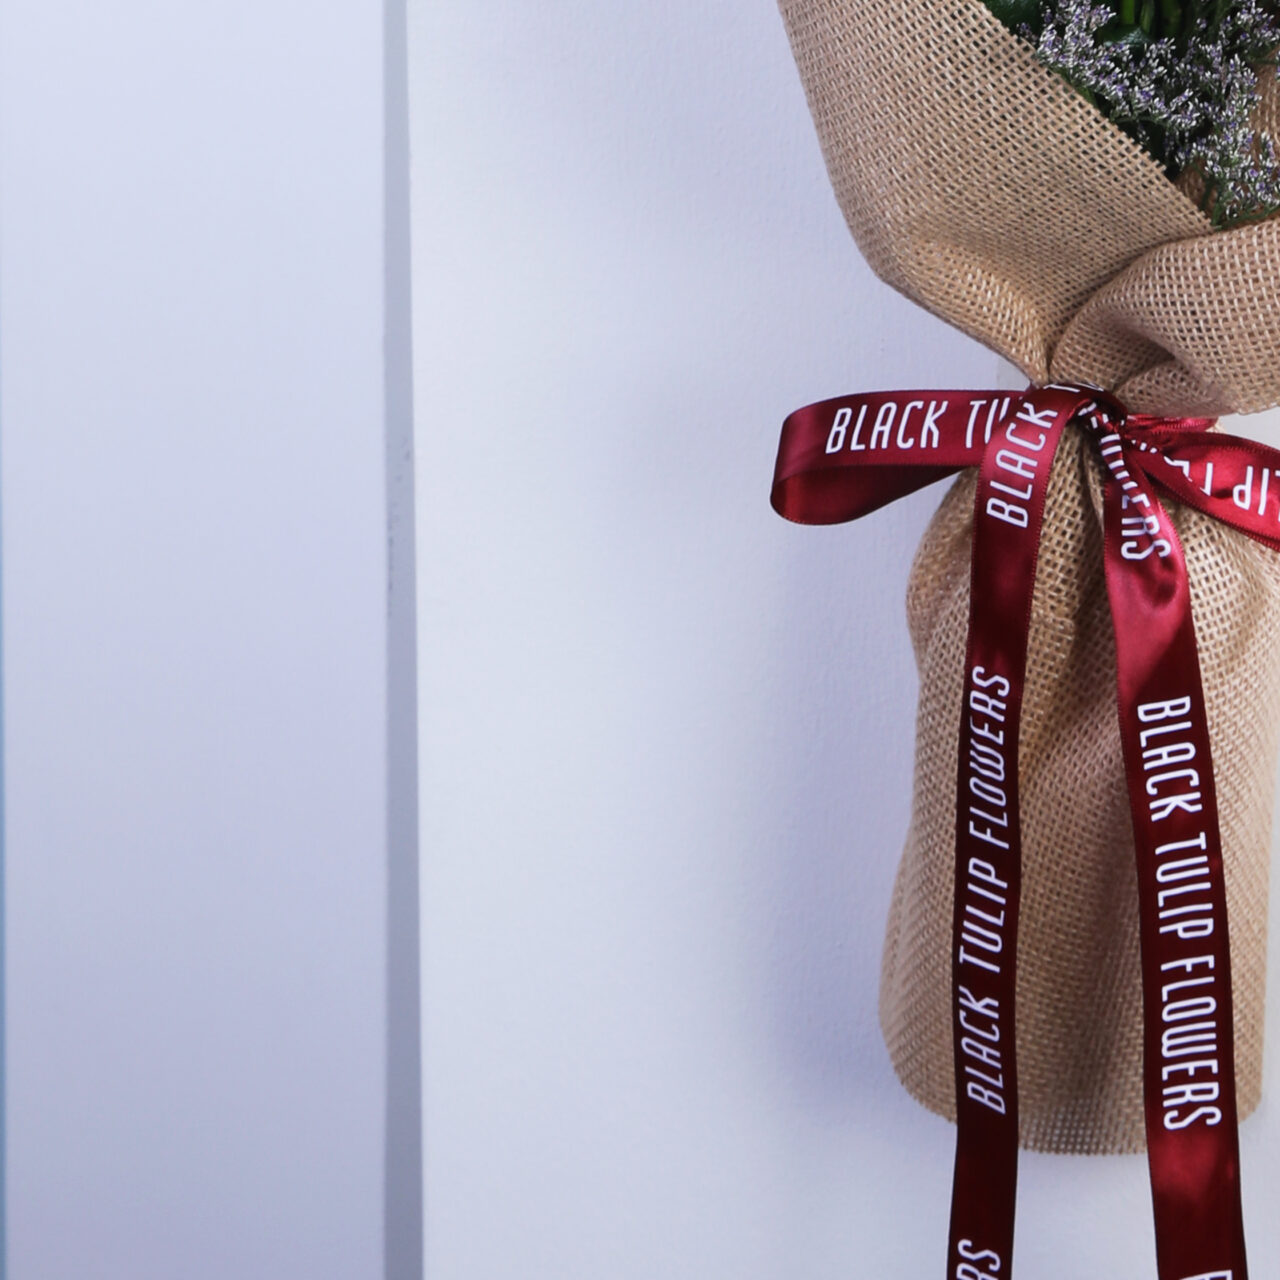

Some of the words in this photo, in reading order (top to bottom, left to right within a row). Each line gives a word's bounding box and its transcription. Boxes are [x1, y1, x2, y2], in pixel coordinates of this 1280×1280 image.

[825, 400, 948, 454] BLACK
[965, 397, 1010, 448] TU
[986, 402, 1058, 528] BLACK
[969, 665, 1010, 849] FLOWERS
[1137, 696, 1202, 822] BLACK
[959, 856, 1008, 973] TULIP
[1155, 831, 1214, 939] TULIP
[959, 985, 1006, 1115] BLACK
[1160, 955, 1222, 1130] FLOWERS
[956, 1239, 1001, 1280] RS
